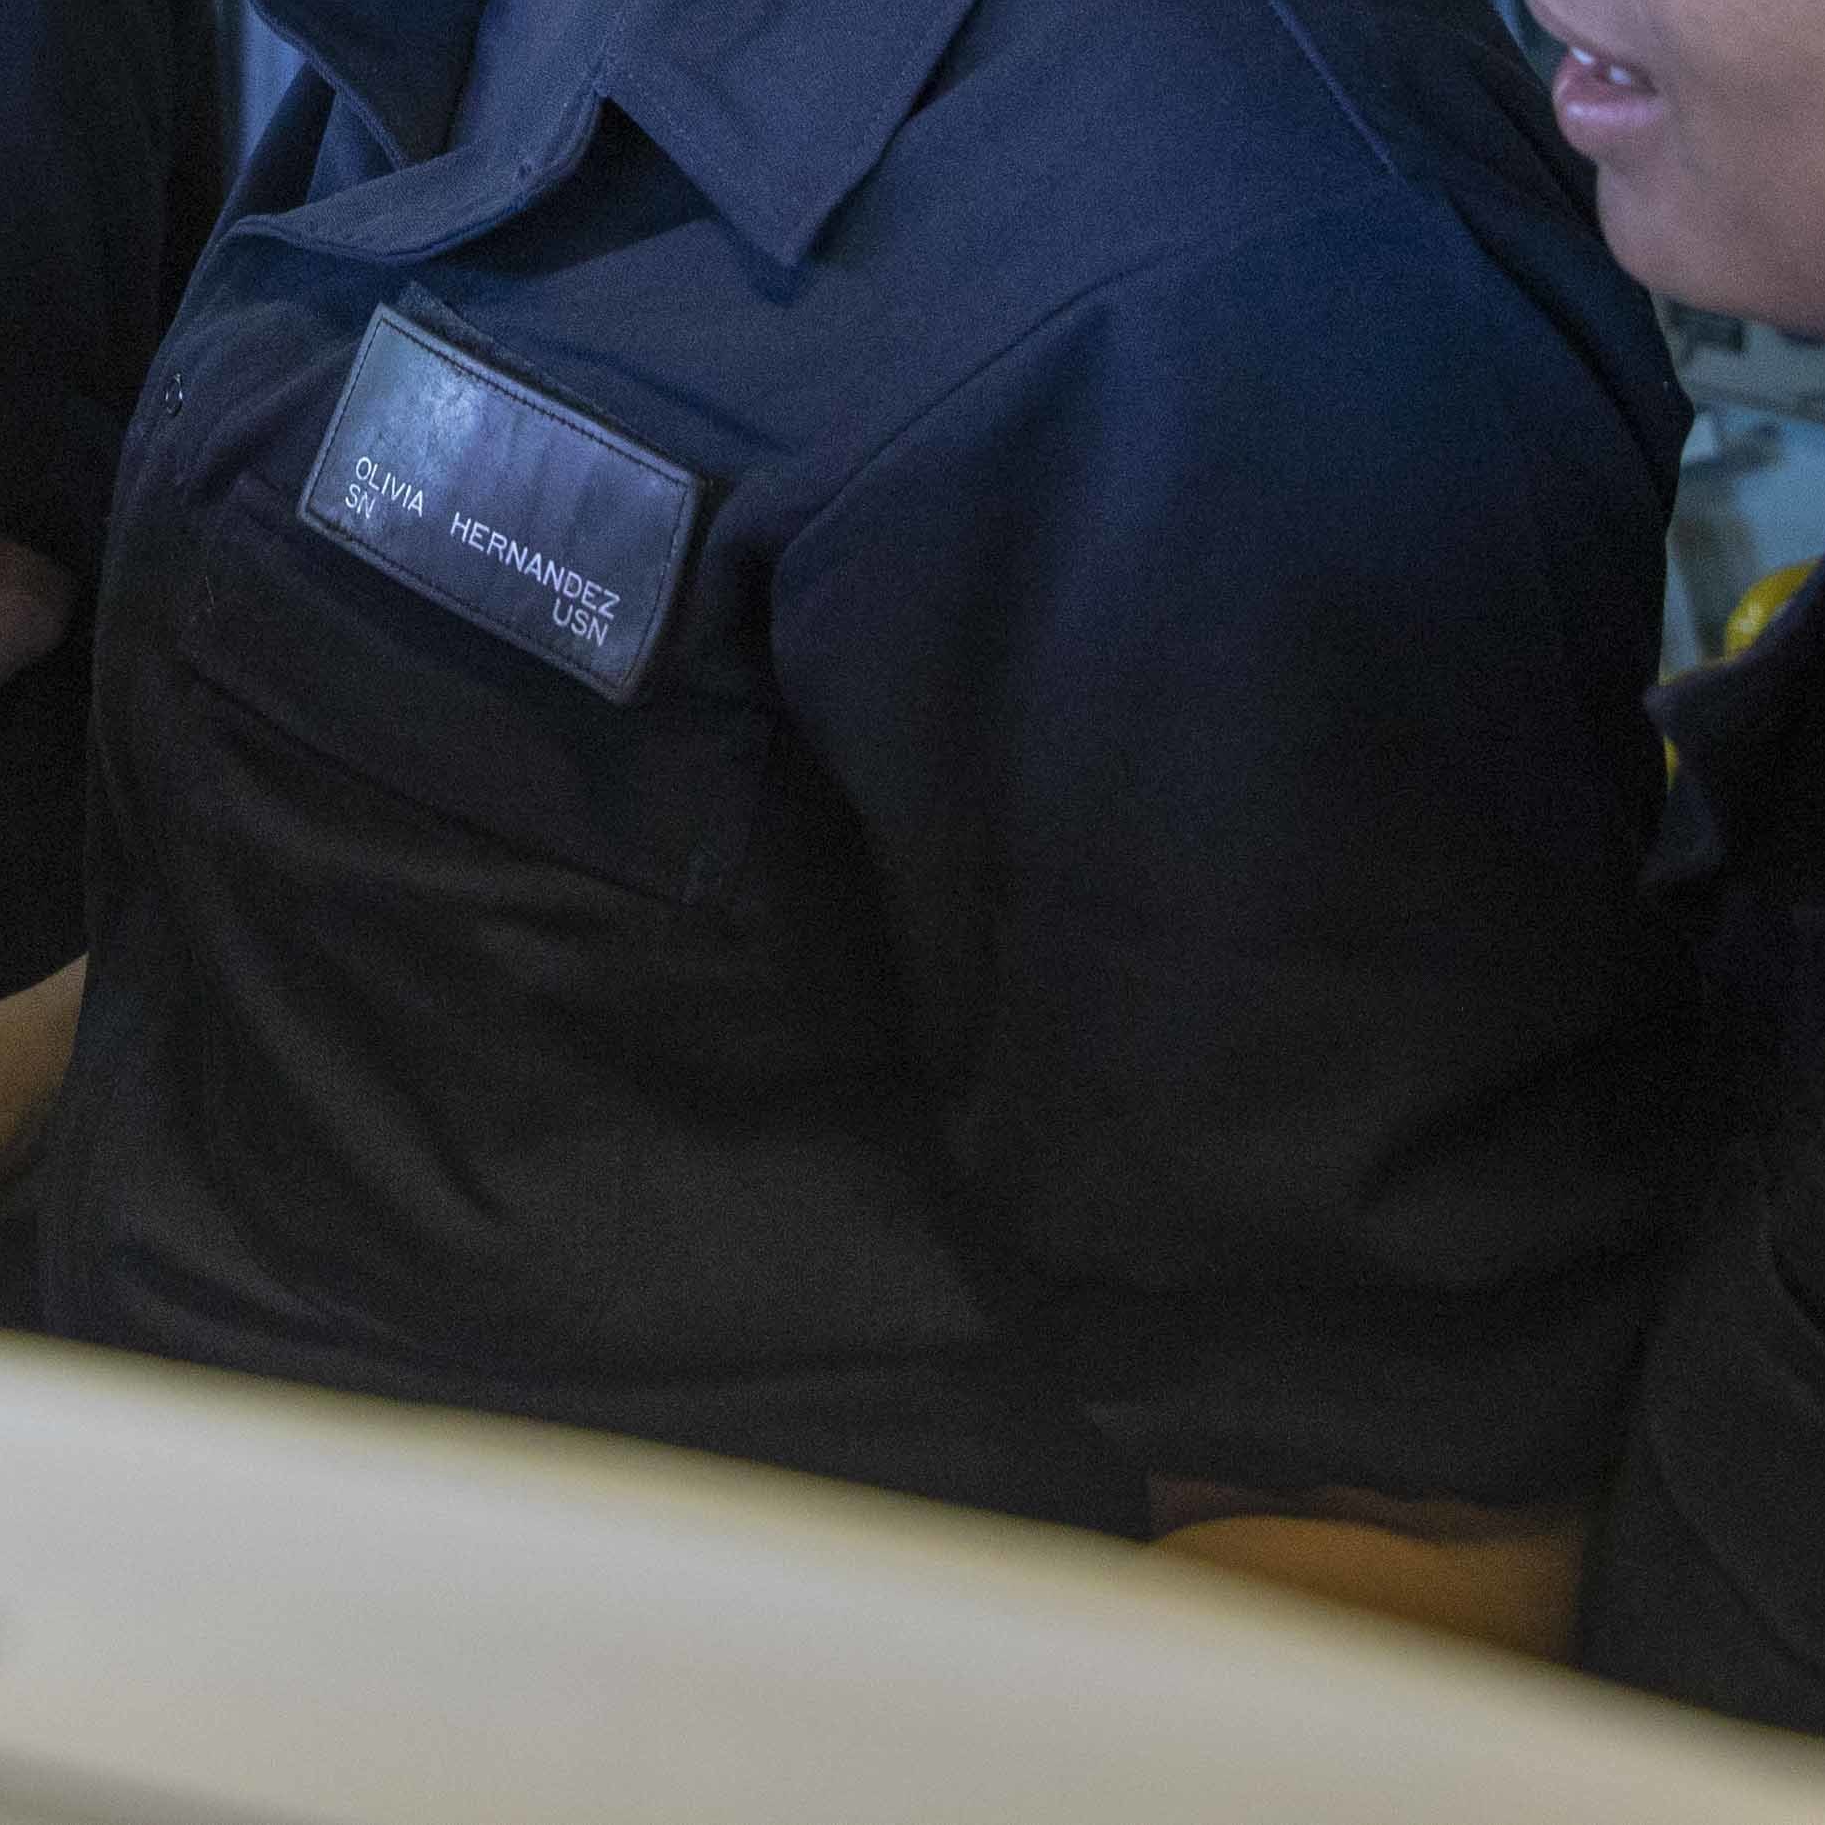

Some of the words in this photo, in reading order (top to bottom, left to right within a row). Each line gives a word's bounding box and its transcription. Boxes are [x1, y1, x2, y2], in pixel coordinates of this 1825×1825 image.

[345, 483, 376, 519] SN
[355, 456, 424, 518] OLIVIA
[450, 511, 621, 619] HERNANDEZ
[552, 597, 608, 647] USN
